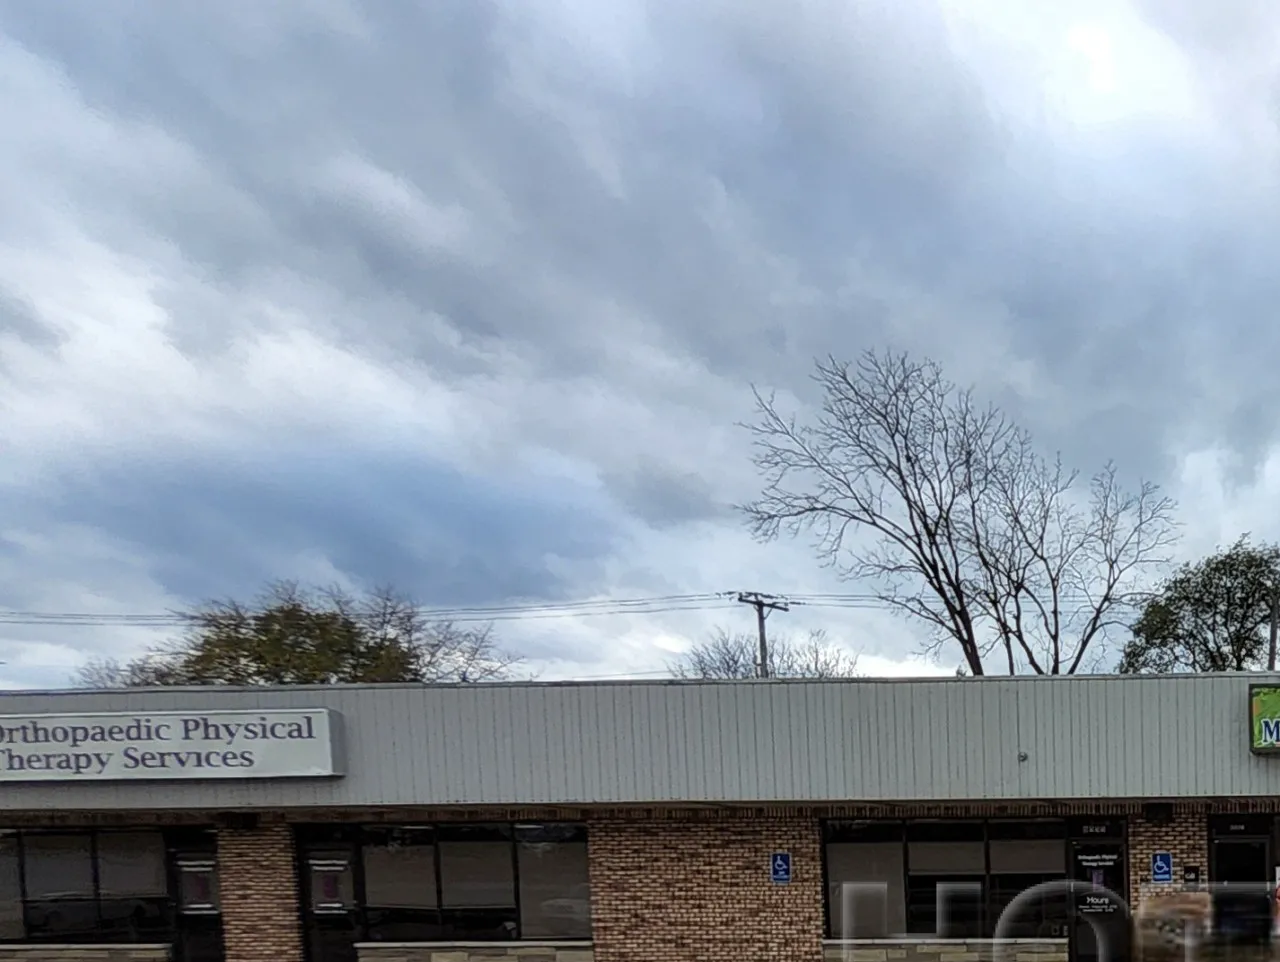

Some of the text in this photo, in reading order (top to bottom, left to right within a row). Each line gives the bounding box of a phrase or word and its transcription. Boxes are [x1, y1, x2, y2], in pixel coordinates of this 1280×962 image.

[0, 715, 317, 747] rthopaedic Physical
[0, 746, 255, 774] herapy Services
